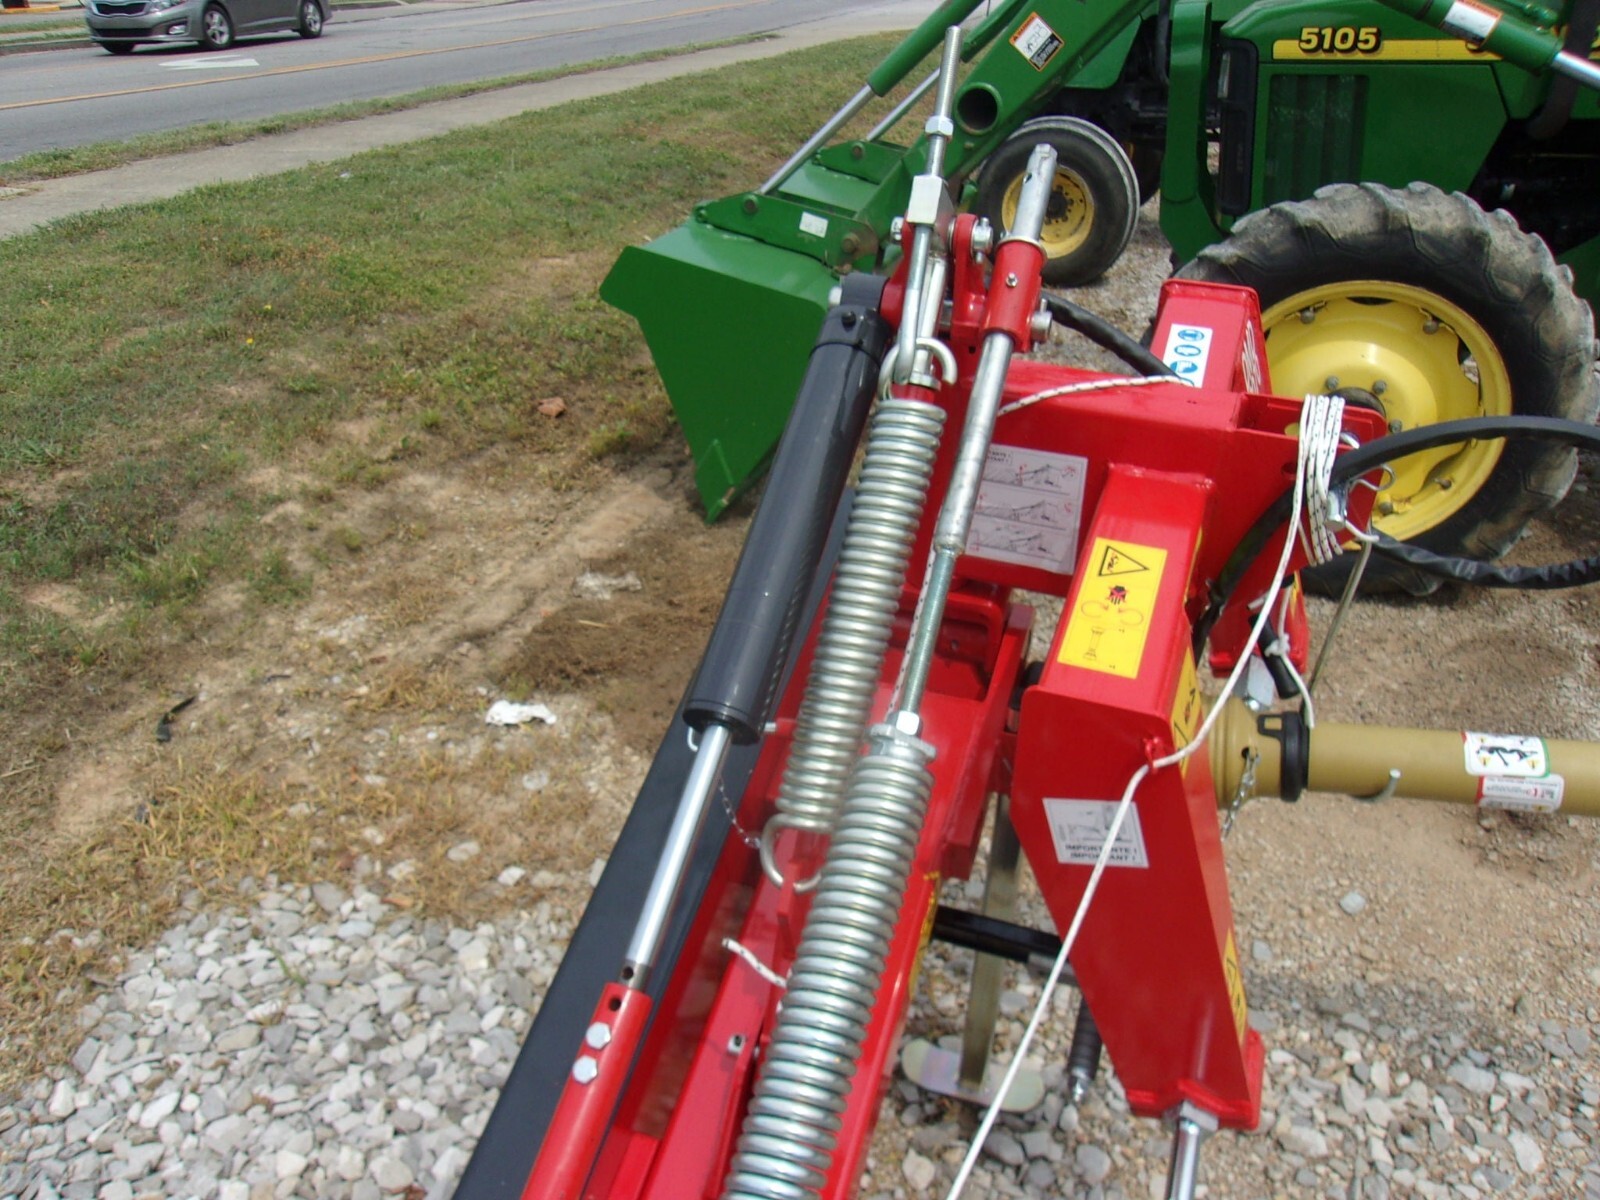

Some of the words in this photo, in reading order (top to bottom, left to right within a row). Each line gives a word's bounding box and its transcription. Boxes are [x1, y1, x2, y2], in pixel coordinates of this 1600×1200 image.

[1299, 26, 1379, 52] 5105
[1065, 844, 1129, 853] IMPORTNTE
[1071, 852, 1128, 860] IMPORANT
